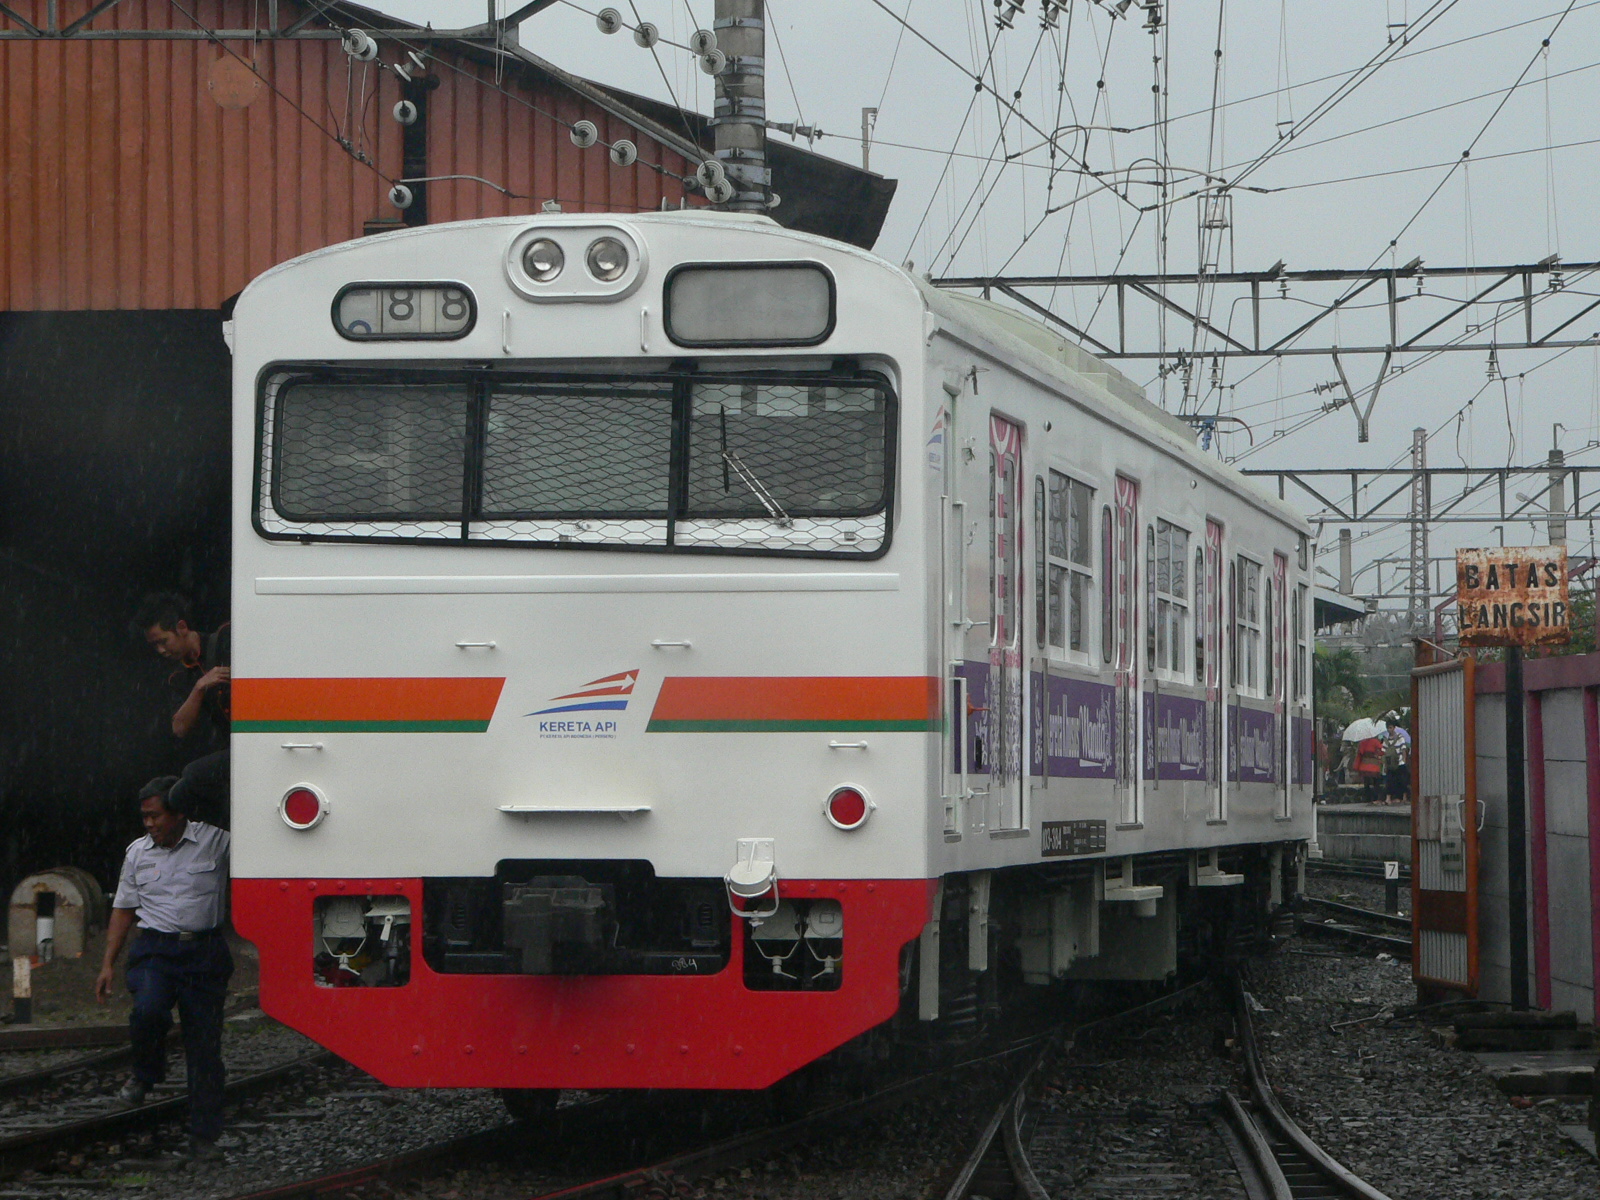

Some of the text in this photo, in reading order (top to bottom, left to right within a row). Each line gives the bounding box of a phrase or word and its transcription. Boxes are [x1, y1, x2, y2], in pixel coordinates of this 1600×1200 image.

[1465, 563, 1558, 589] BATAS
[1459, 602, 1566, 629] LANGSIR
[539, 721, 617, 732] KERETA API
[1388, 863, 1396, 877] 7
